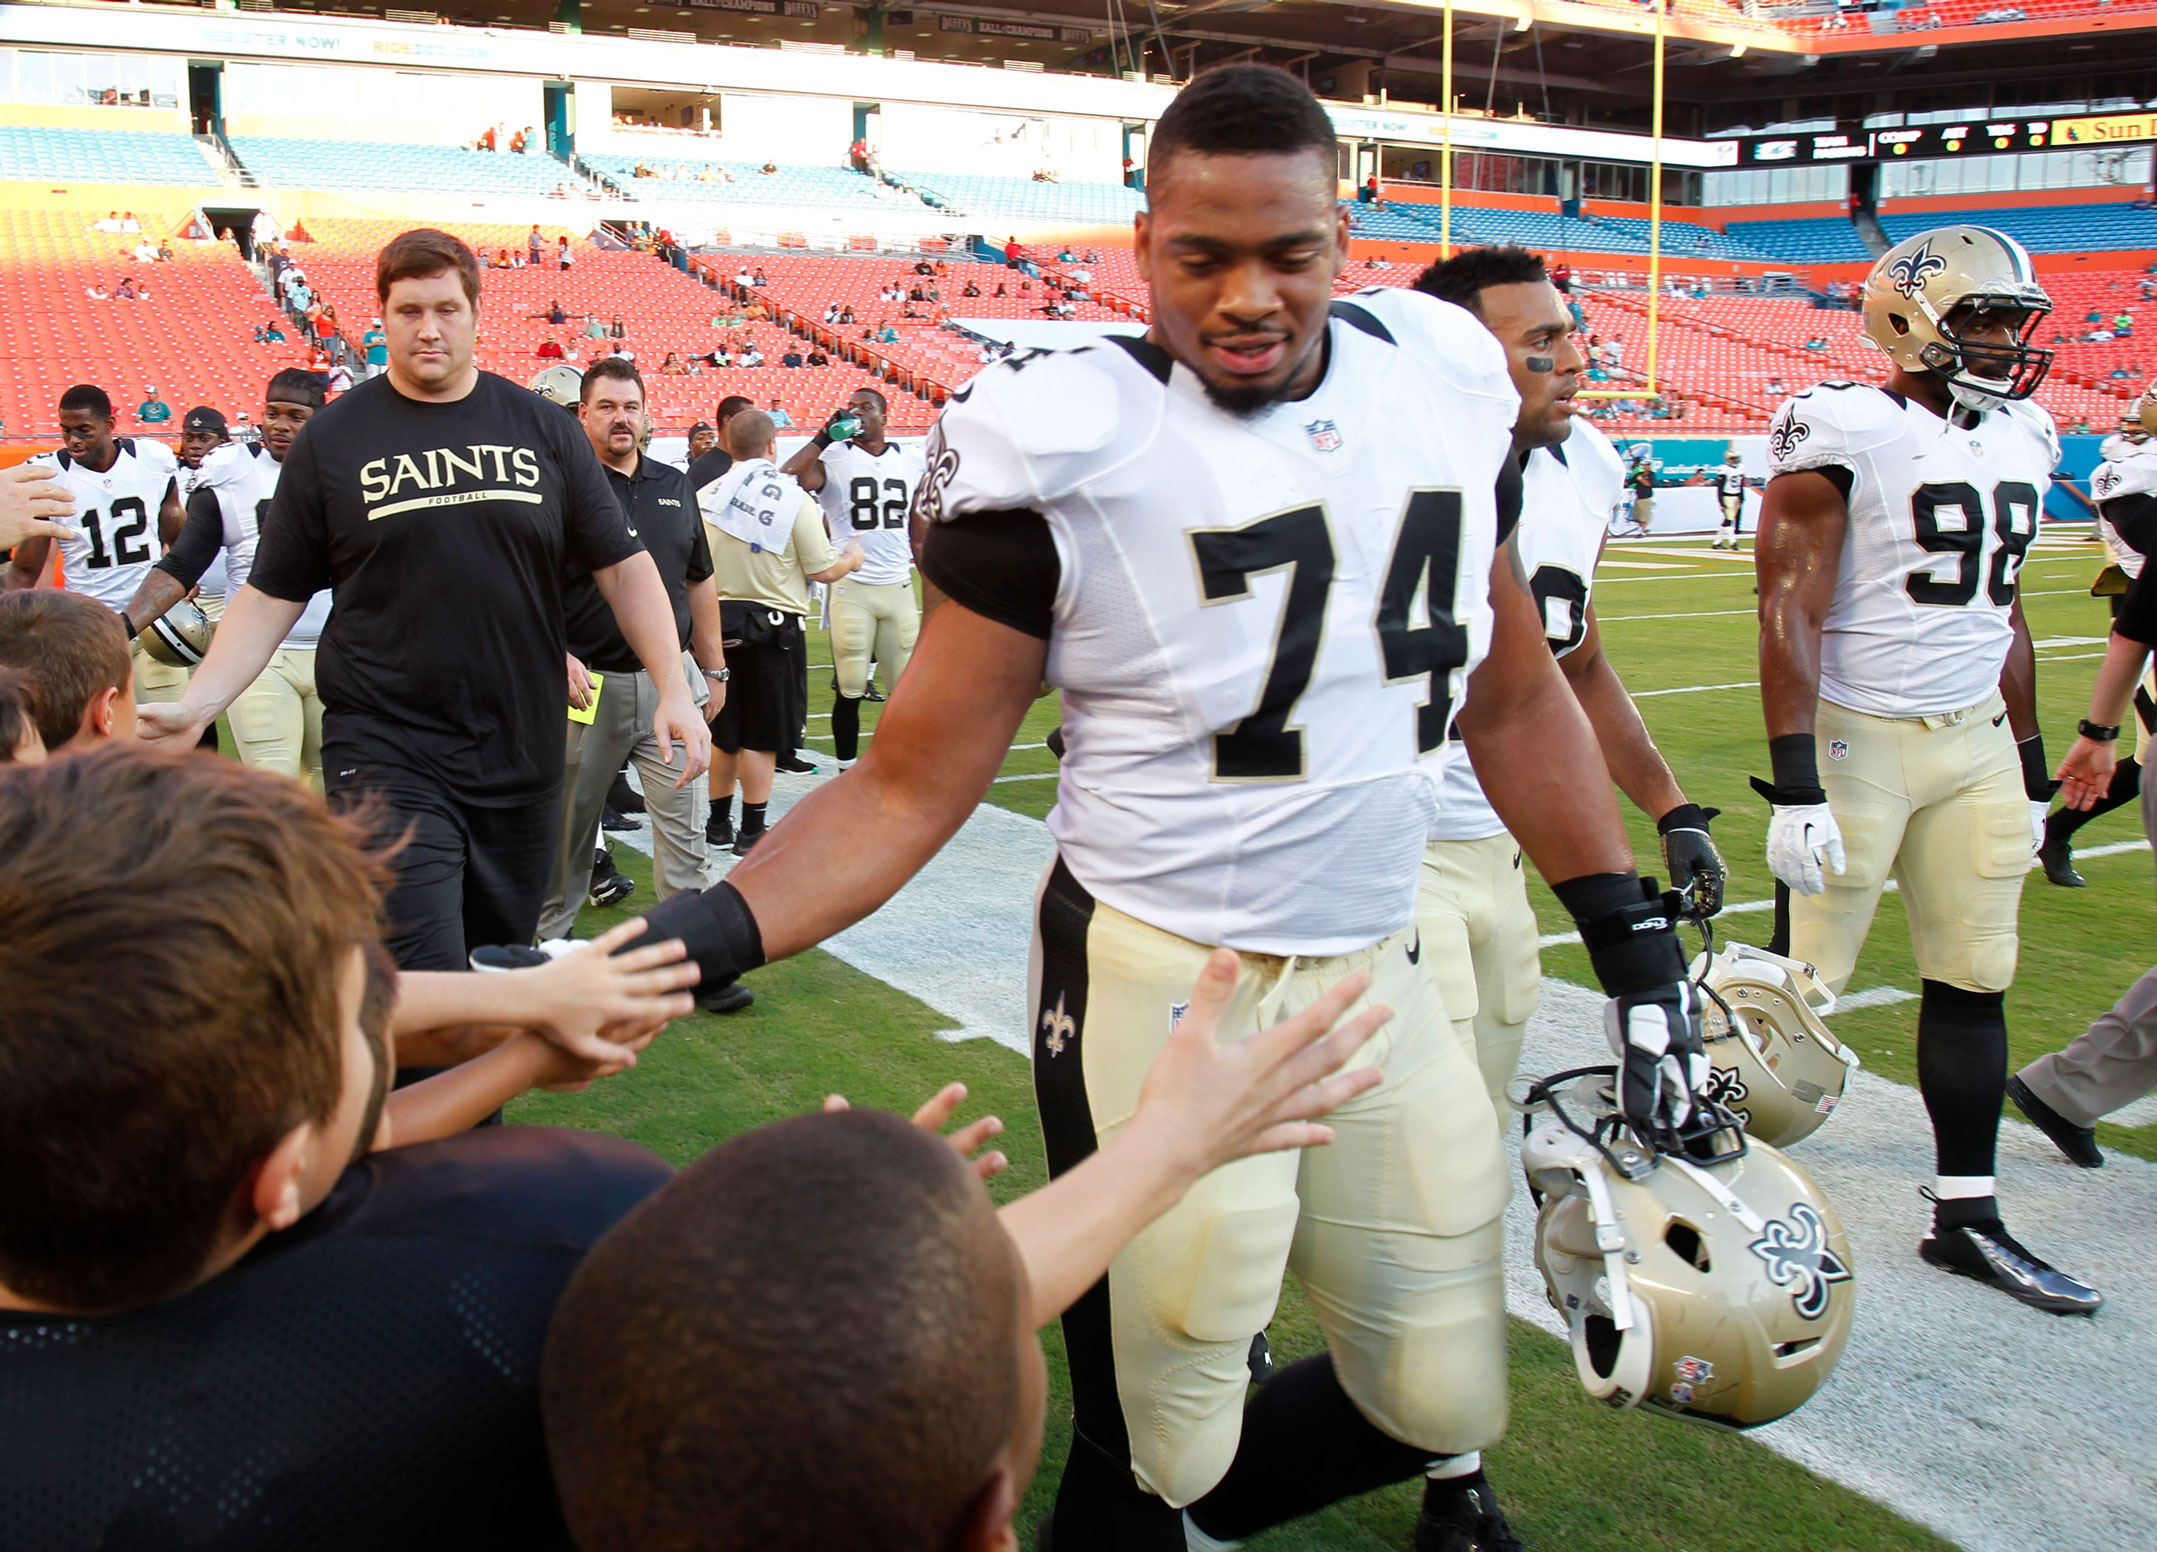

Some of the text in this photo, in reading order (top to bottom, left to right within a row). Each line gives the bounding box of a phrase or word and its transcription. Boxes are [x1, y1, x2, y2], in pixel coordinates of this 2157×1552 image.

[296, 36, 341, 50] NOW!
[2093, 122, 2141, 140] Sun
[360, 445, 540, 503] SAINTS
[428, 492, 488, 506] FOOTBALL
[850, 476, 908, 530] 82
[81, 496, 150, 569] 12
[1905, 479, 2039, 608] 98
[1183, 486, 1471, 783] 74
